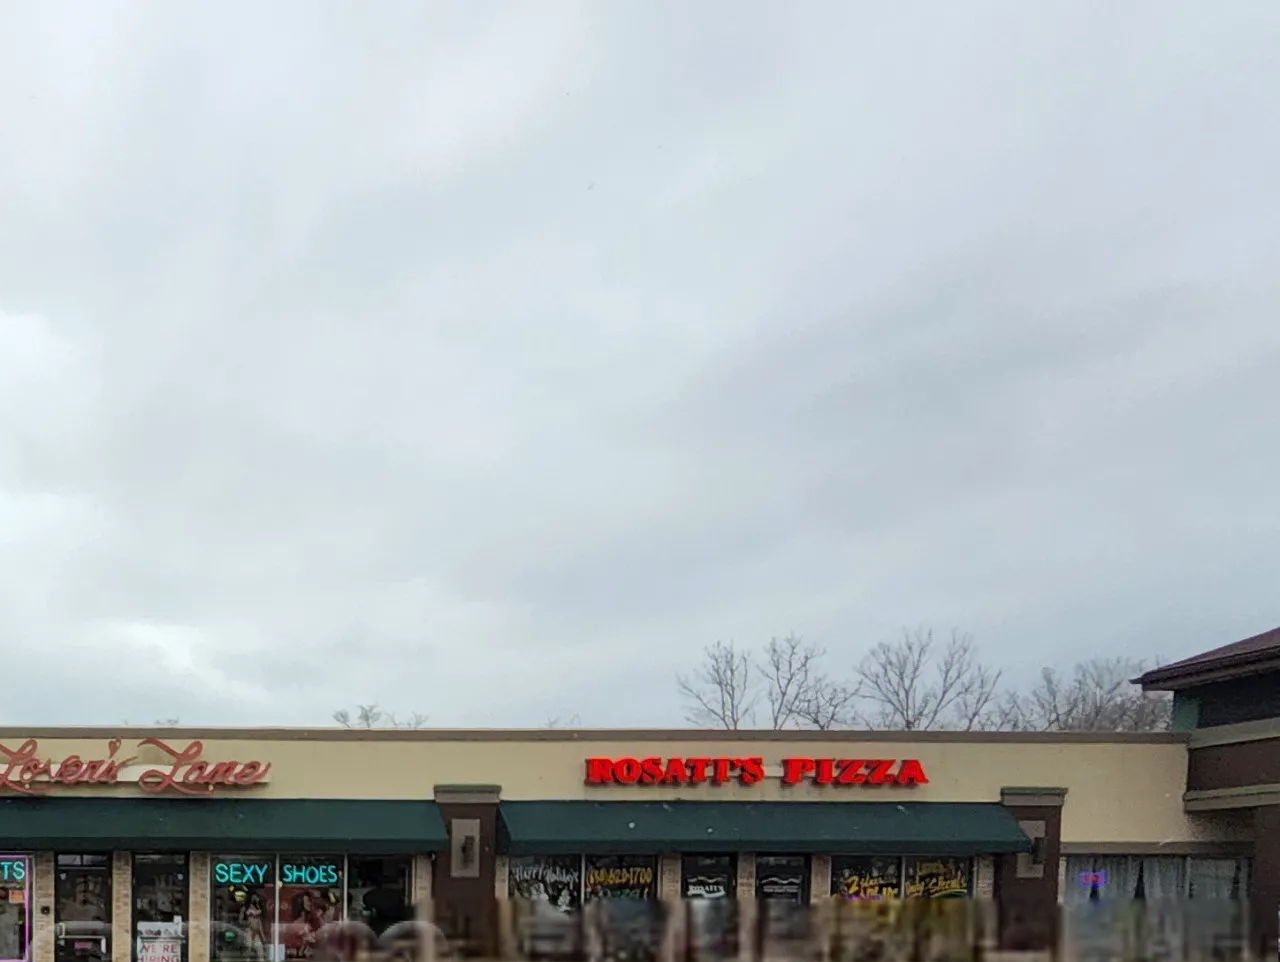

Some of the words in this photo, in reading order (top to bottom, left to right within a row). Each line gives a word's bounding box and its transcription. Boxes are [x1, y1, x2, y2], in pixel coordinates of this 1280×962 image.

[137, 737, 272, 795] Lane
[584, 757, 766, 786] ROSATI'S
[781, 758, 930, 786] PIZZA
[214, 863, 268, 884] SEXY
[282, 864, 338, 884] SHOES
